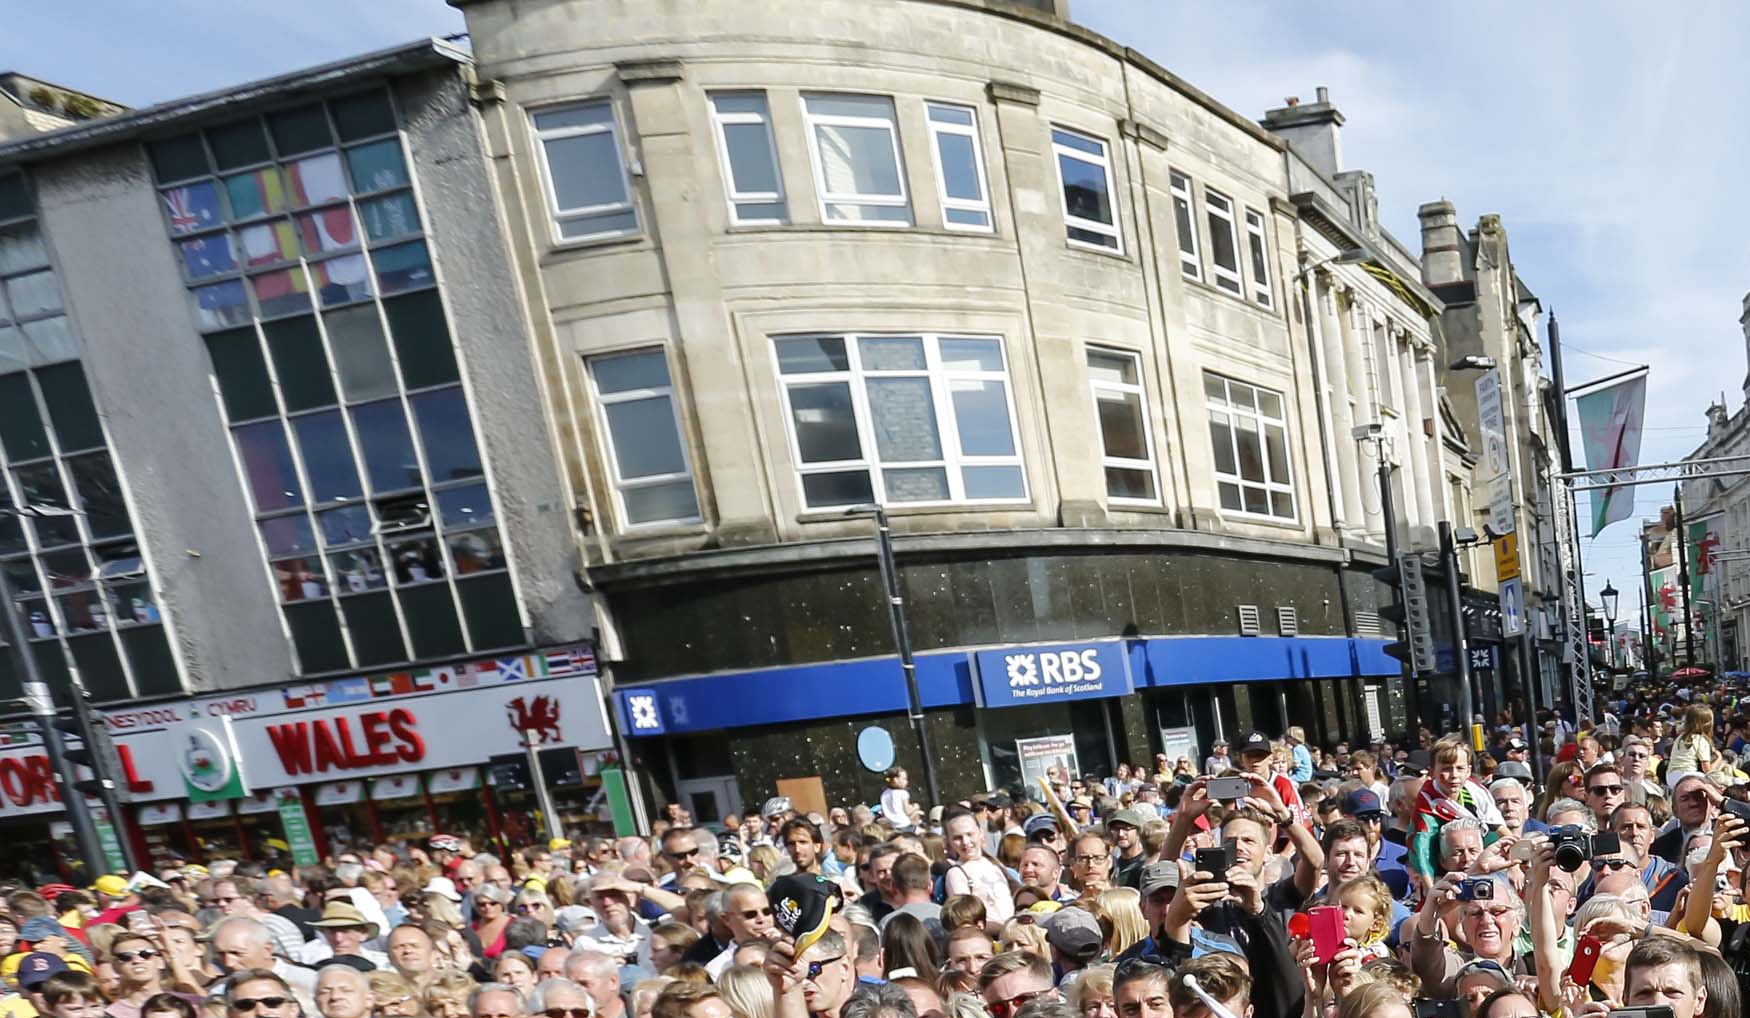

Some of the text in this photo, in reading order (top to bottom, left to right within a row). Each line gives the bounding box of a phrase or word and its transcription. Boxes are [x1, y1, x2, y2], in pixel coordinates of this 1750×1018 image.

[1040, 649, 1101, 684] RBS
[1013, 689, 1025, 698] The
[1026, 688, 1045, 698] Royal
[1047, 686, 1064, 695] Bank
[1073, 683, 1102, 693] Scotland
[266, 708, 426, 776] WALES
